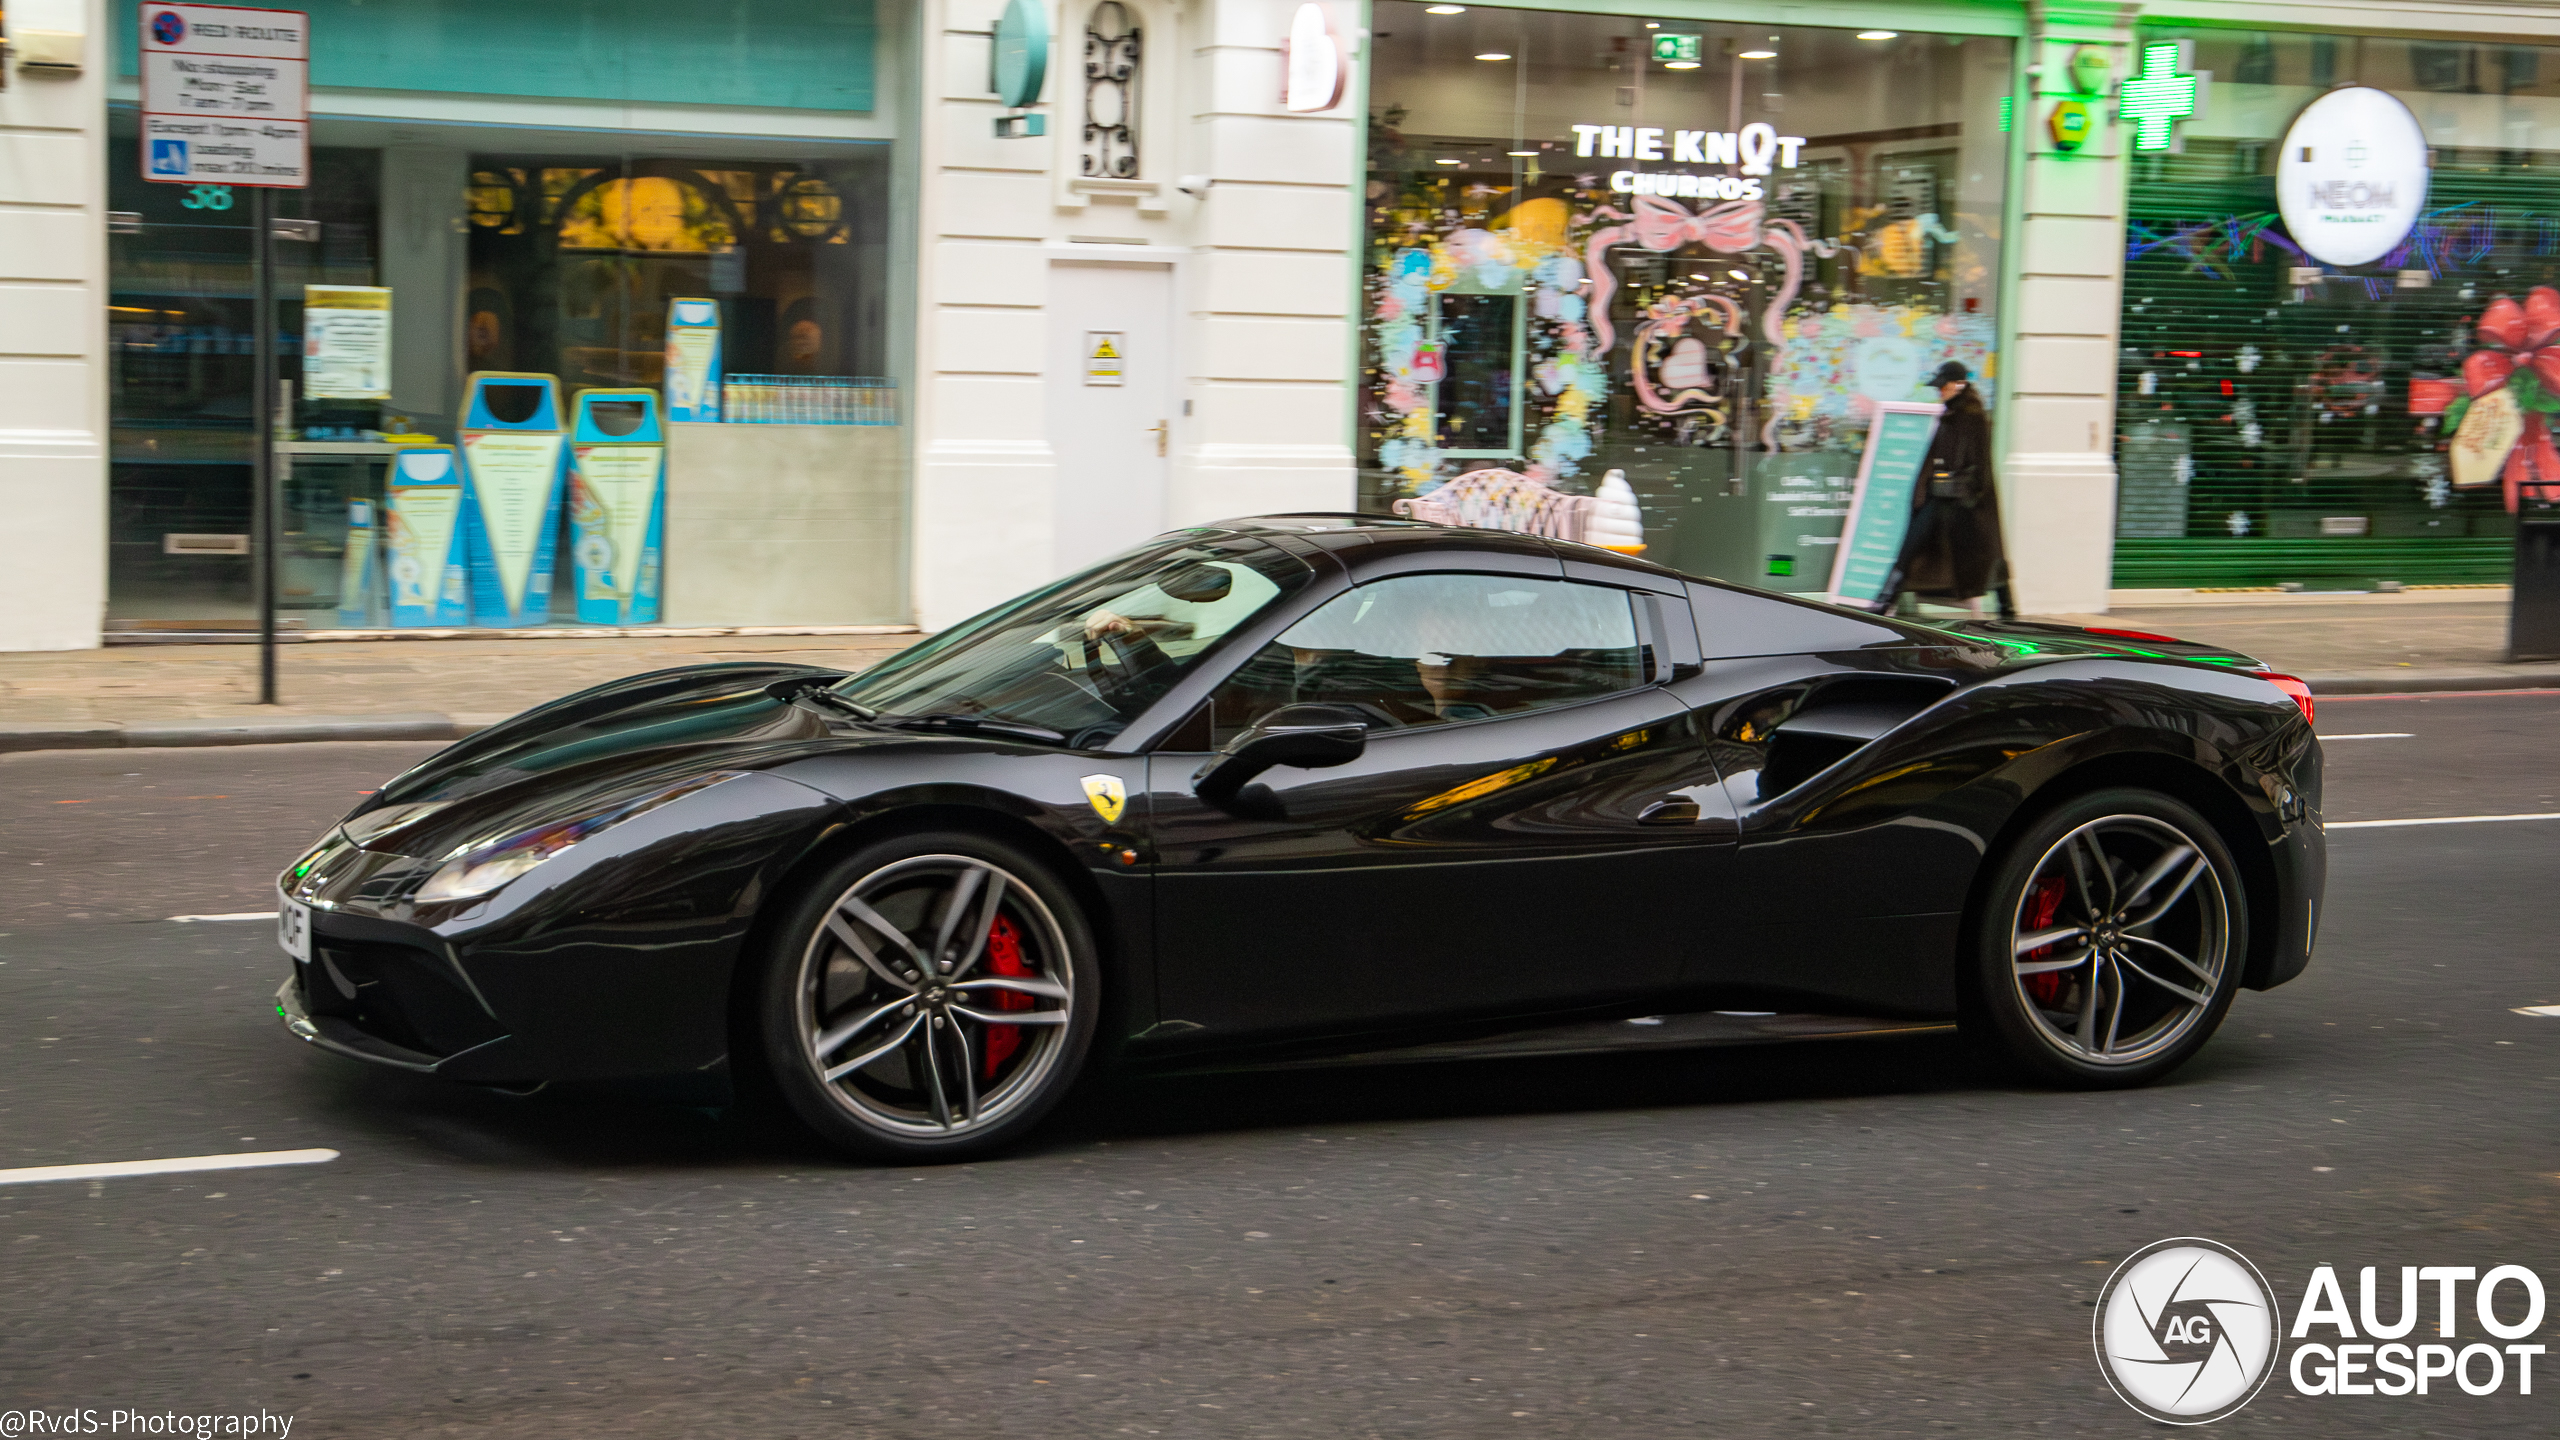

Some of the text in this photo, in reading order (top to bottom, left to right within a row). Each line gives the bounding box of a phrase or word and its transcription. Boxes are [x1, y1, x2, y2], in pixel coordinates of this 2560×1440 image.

[191, 23, 301, 42] RED ROUTE
[1571, 122, 1807, 176] THE KNOT
[1610, 170, 1764, 201] CHURROS
